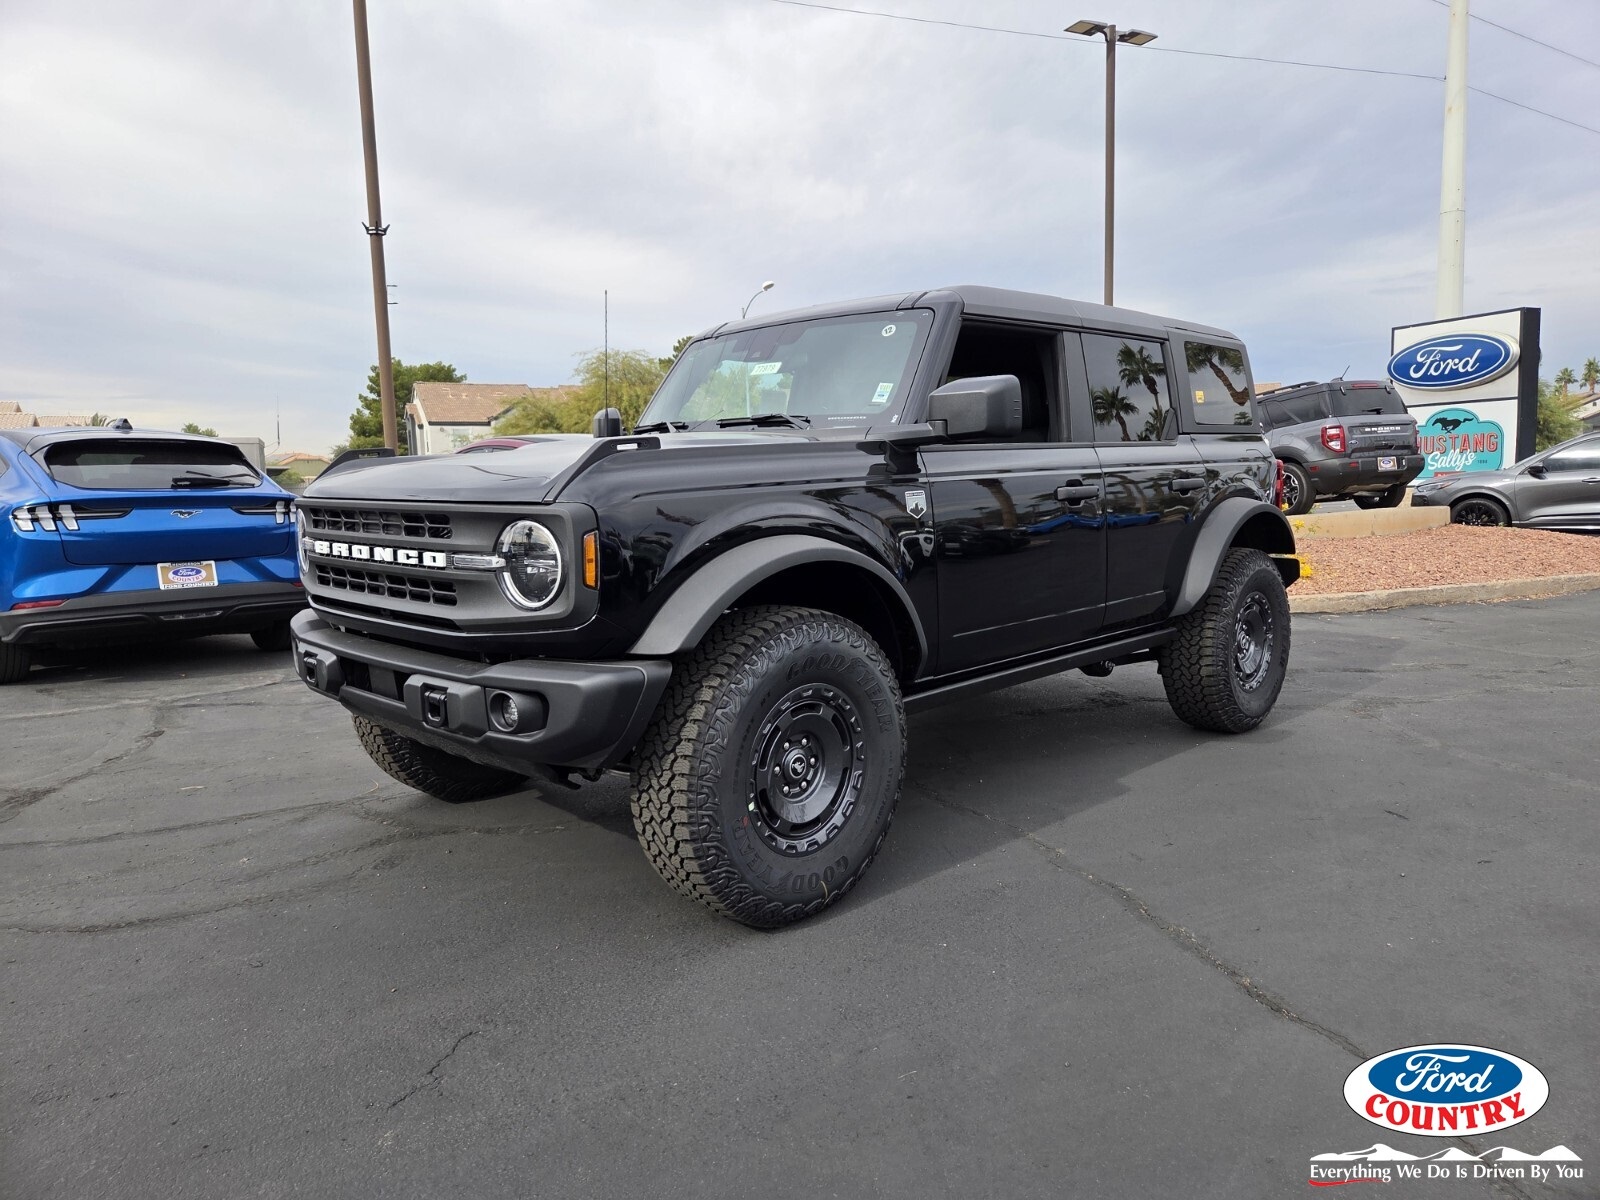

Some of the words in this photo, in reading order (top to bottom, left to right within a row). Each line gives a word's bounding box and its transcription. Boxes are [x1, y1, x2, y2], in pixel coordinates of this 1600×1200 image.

[884, 326, 894, 335] 12
[1409, 344, 1482, 379] Ford
[1427, 448, 1477, 471] Sally's
[315, 541, 447, 567] BRONCO
